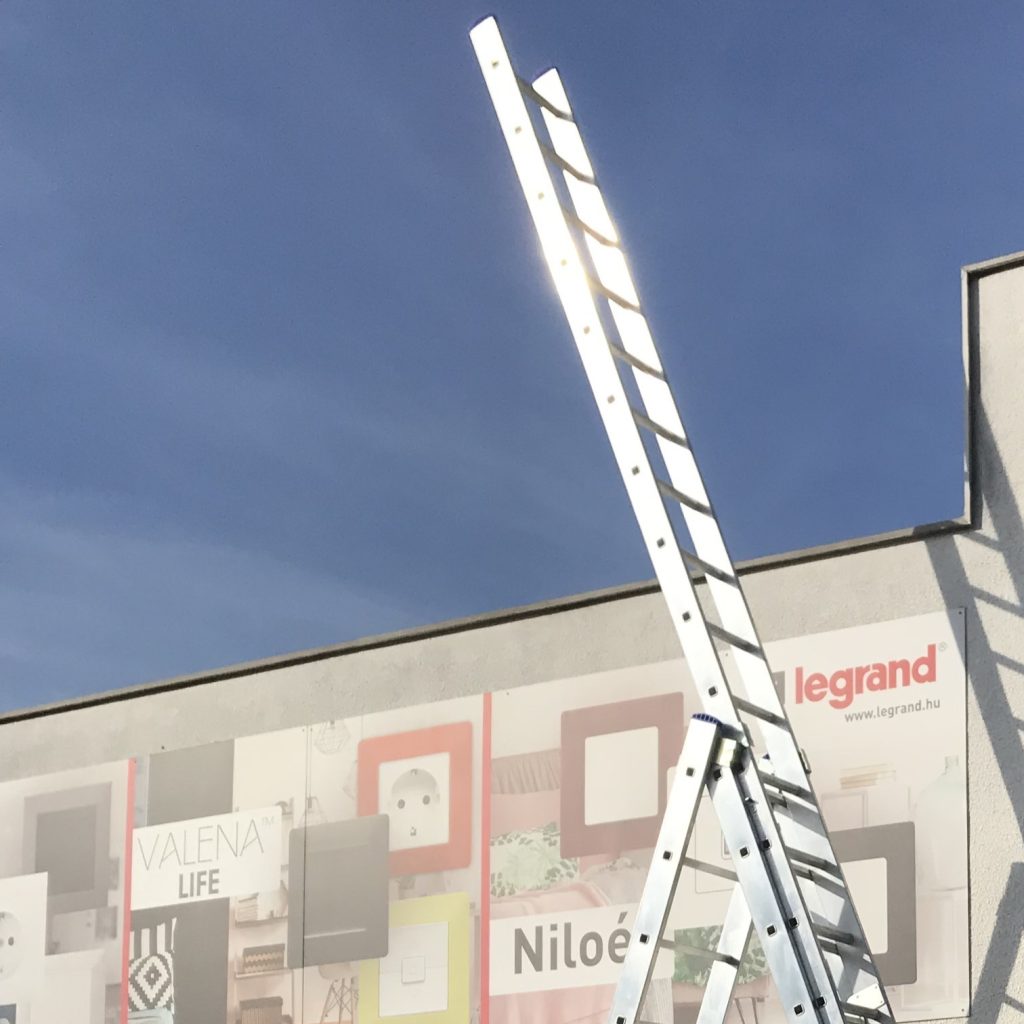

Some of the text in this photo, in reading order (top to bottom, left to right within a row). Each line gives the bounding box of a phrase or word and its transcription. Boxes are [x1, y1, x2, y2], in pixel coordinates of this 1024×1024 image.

[795, 643, 937, 710] legrand
[844, 699, 941, 723] www.legrand.hu
[137, 818, 264, 871] VALENA
[178, 868, 220, 899] LIFE
[514, 911, 632, 975] Niloé
